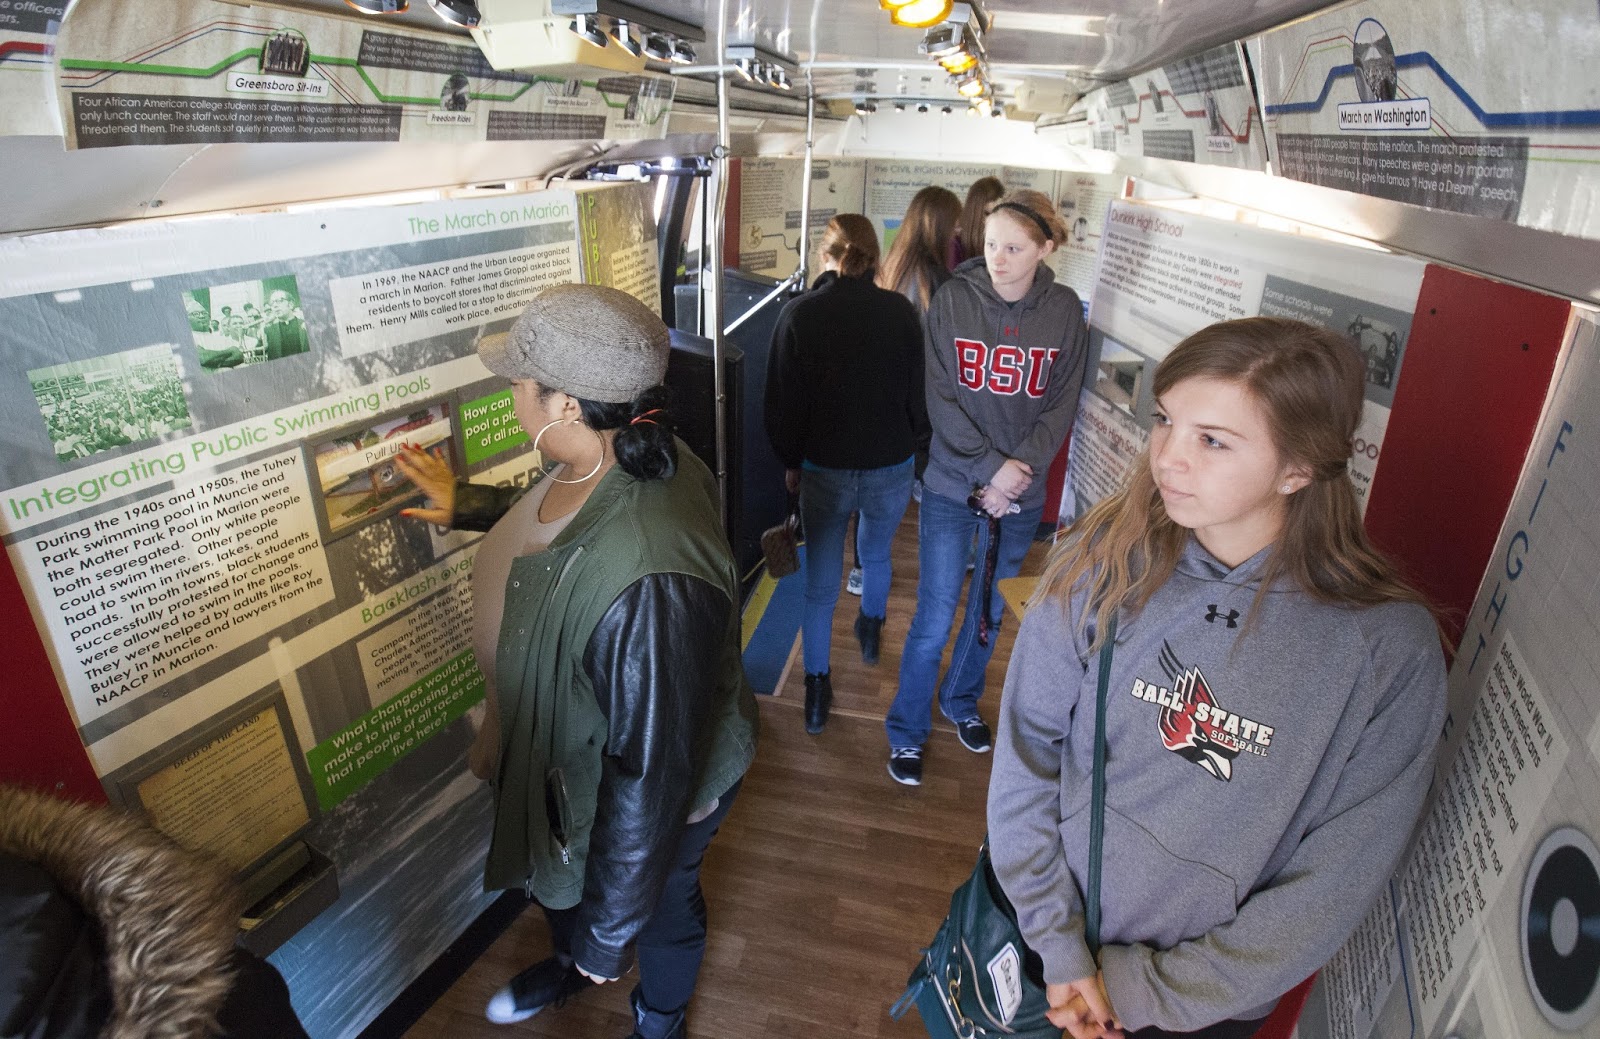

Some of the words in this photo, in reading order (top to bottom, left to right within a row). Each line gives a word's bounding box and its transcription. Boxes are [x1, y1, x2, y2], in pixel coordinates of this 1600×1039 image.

[14, 1, 63, 16] officers
[79, 96, 101, 107] Four
[104, 97, 141, 107] African
[143, 99, 188, 108] American
[190, 100, 222, 111] college
[224, 101, 257, 111] students
[258, 103, 269, 111] sat
[271, 103, 293, 112] down
[235, 78, 295, 92] Greensboro
[296, 81, 322, 93] Sit-Ins
[80, 111, 102, 122] only
[104, 111, 132, 121] lunch
[134, 112, 173, 121] counter.
[175, 112, 190, 120] The
[1341, 110, 1361, 123] March
[1363, 113, 1373, 123] on
[1374, 108, 1427, 127] Washington
[890, 165, 911, 173] CIVIL
[913, 166, 943, 175] RIGHTS
[945, 167, 998, 176] MOVEMENT
[1379, 159, 1410, 171] speeches
[1411, 161, 1429, 172] were
[1431, 161, 1453, 176] given
[1454, 163, 1464, 177] by
[1466, 163, 1514, 179] important
[1380, 141, 1391, 151] the
[1392, 141, 1416, 153] nation.
[1417, 141, 1429, 151] The
[1431, 142, 1458, 155] march
[1459, 143, 1504, 158] protested
[408, 216, 439, 235] The
[445, 209, 496, 231] March
[500, 210, 519, 224] on
[523, 203, 569, 221] Marion
[1110, 209, 1136, 226] Dunkirk
[1137, 213, 1153, 233] High
[1155, 218, 1184, 237] School
[362, 281, 372, 290] In
[402, 273, 416, 282] the
[419, 267, 450, 279] NAACP
[452, 263, 468, 274] and
[470, 261, 483, 270] the
[485, 256, 507, 268] Urban
[509, 251, 535, 263] League
[537, 246, 570, 259] organized
[954, 337, 1061, 398] BSU
[464, 405, 488, 421] How
[490, 397, 511, 411] can
[465, 419, 490, 440] pool
[492, 417, 500, 427] a
[9, 452, 186, 520] Integrating
[191, 426, 268, 462] Public
[274, 390, 381, 436] Swimming
[384, 376, 431, 402] Pools
[366, 447, 387, 464] Pull
[481, 434, 491, 447] of
[494, 429, 506, 441] all
[36, 527, 91, 552] During
[94, 517, 120, 532] the
[124, 501, 165, 521] 1940s
[168, 489, 196, 505] and
[199, 476, 238, 494] 1950s,
[240, 467, 260, 481] the
[263, 455, 297, 472] Tuhey
[42, 547, 80, 567] Park
[84, 519, 160, 552] swimming
[164, 504, 195, 525] pool
[198, 500, 209, 511] in
[213, 483, 258, 505] Muncie
[262, 472, 285, 487] and
[47, 566, 75, 582] the
[80, 545, 129, 570] Matter
[133, 531, 166, 550] Park
[168, 520, 199, 537] Pool
[201, 514, 213, 524] in
[216, 497, 259, 519] Marion
[262, 485, 290, 501] were
[53, 576, 92, 597] both
[95, 540, 184, 581] segregated.
[191, 526, 221, 543] Only
[225, 511, 257, 530] white
[260, 495, 301, 518] people
[60, 586, 106, 611] could
[110, 570, 147, 591] swim
[150, 554, 191, 575] there.
[197, 536, 233, 555] Other
[236, 518, 278, 542] people
[64, 605, 97, 626] had
[100, 599, 116, 612] to
[120, 582, 157, 603] swim
[159, 576, 173, 586] in
[175, 560, 214, 580] rivers,
[217, 543, 253, 562] lakes,
[256, 530, 279, 546] and
[70, 613, 123, 642] ponds.
[131, 603, 145, 614] In
[148, 586, 180, 606] both
[183, 570, 224, 591] towns,
[227, 551, 263, 572] black
[264, 531, 310, 556] students
[361, 576, 436, 623] Backlash
[441, 556, 473, 580] over
[75, 609, 164, 654] successfully
[168, 579, 229, 614] protested
[232, 571, 248, 584] for
[251, 551, 295, 576] change
[297, 539, 319, 555] and
[332, 720, 368, 749] What
[370, 686, 424, 725] changes
[425, 662, 459, 689] would
[1130, 677, 1184, 713] BALL
[1194, 702, 1275, 746] STATE
[1493, 662, 1512, 702] African
[1509, 700, 1541, 768] Americans
[1500, 642, 1518, 680] Before
[1516, 674, 1535, 714] World
[1532, 707, 1547, 739] War
[174, 749, 199, 769] DEED
[201, 742, 213, 754] OF
[216, 730, 233, 745] THE
[236, 715, 261, 734] LAND
[323, 740, 363, 773] make
[365, 731, 379, 745] to
[381, 718, 401, 734] this
[404, 686, 449, 719] housing
[325, 763, 355, 787] that
[356, 731, 401, 769] people
[403, 722, 417, 734] of
[418, 709, 432, 724] all
[433, 689, 465, 713] races
[392, 737, 414, 756] live
[416, 711, 448, 740] here?
[1211, 730, 1268, 757] SOFTBALL
